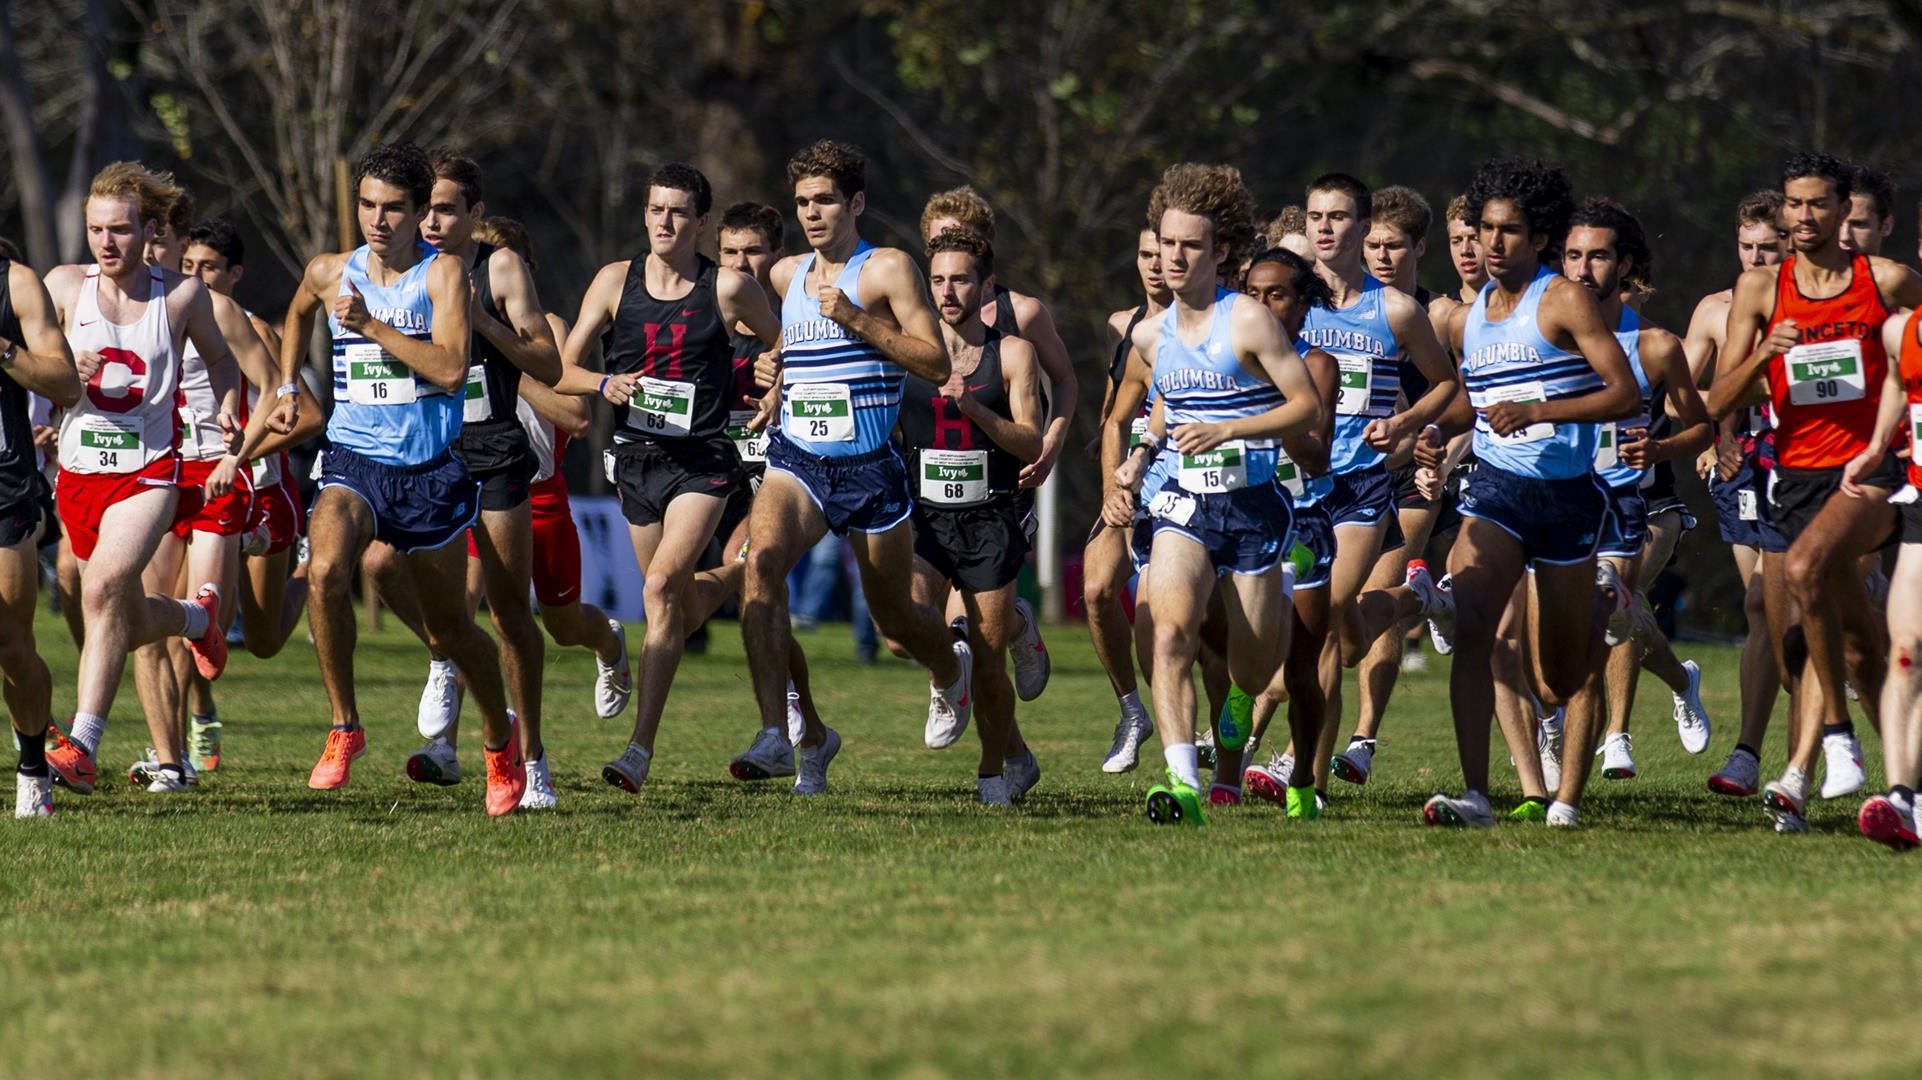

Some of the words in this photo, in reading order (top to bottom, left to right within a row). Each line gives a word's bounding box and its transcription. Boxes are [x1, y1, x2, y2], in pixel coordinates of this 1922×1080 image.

[643, 322, 687, 378] H
[1299, 328, 1386, 358] OLUMBIA
[363, 363, 383, 378] Ivy
[1806, 363, 1830, 377] Ivy
[86, 346, 147, 414] C
[371, 382, 388, 399] 16
[1815, 380, 1838, 398] 90
[643, 394, 664, 410] Ivy
[803, 401, 822, 416] Ivy
[647, 413, 666, 430] 63
[809, 420, 829, 437] 25
[929, 396, 974, 450] H
[93, 432, 113, 447] Ivy
[99, 451, 118, 467] 34
[938, 466, 958, 480] Ivy
[1202, 470, 1220, 488] 15
[944, 483, 964, 499] 68
